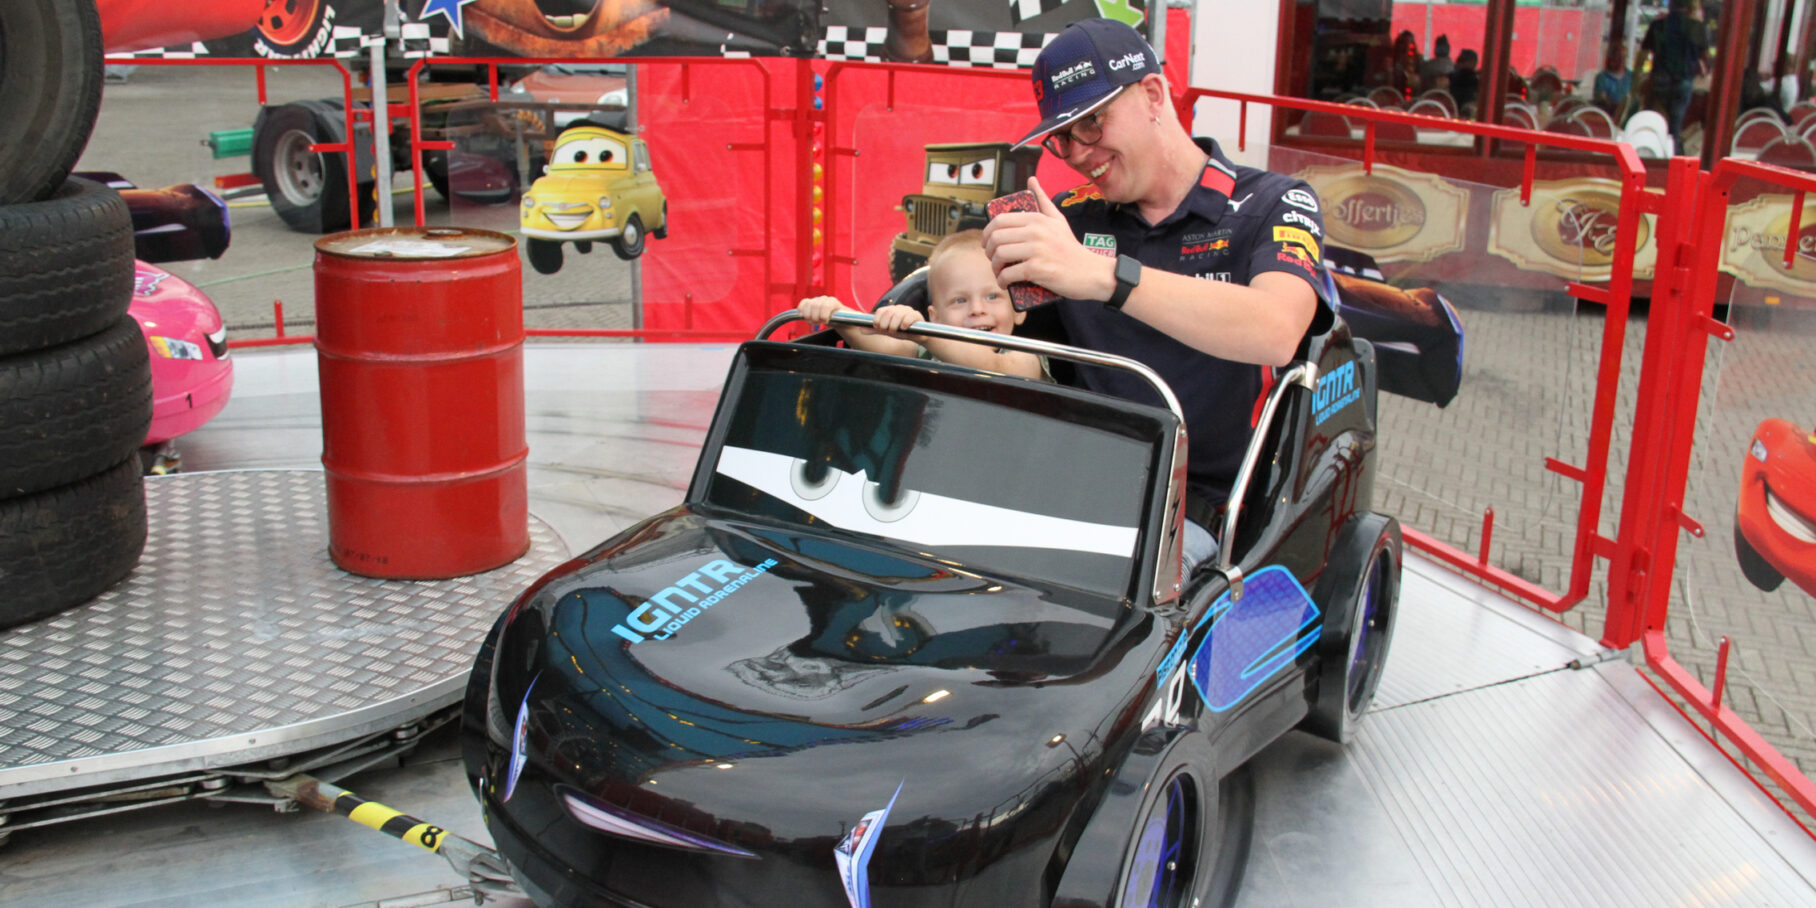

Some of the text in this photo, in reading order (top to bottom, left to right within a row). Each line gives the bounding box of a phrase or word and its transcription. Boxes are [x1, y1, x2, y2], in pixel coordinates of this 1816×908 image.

[1109, 52, 1145, 71] CarNext
[1088, 235, 1114, 248] TAG
[186, 393, 193, 409] 1
[610, 559, 746, 645] IGNTR
[653, 558, 779, 641] LIQUID ADRENALINE
[420, 825, 443, 849] 8
